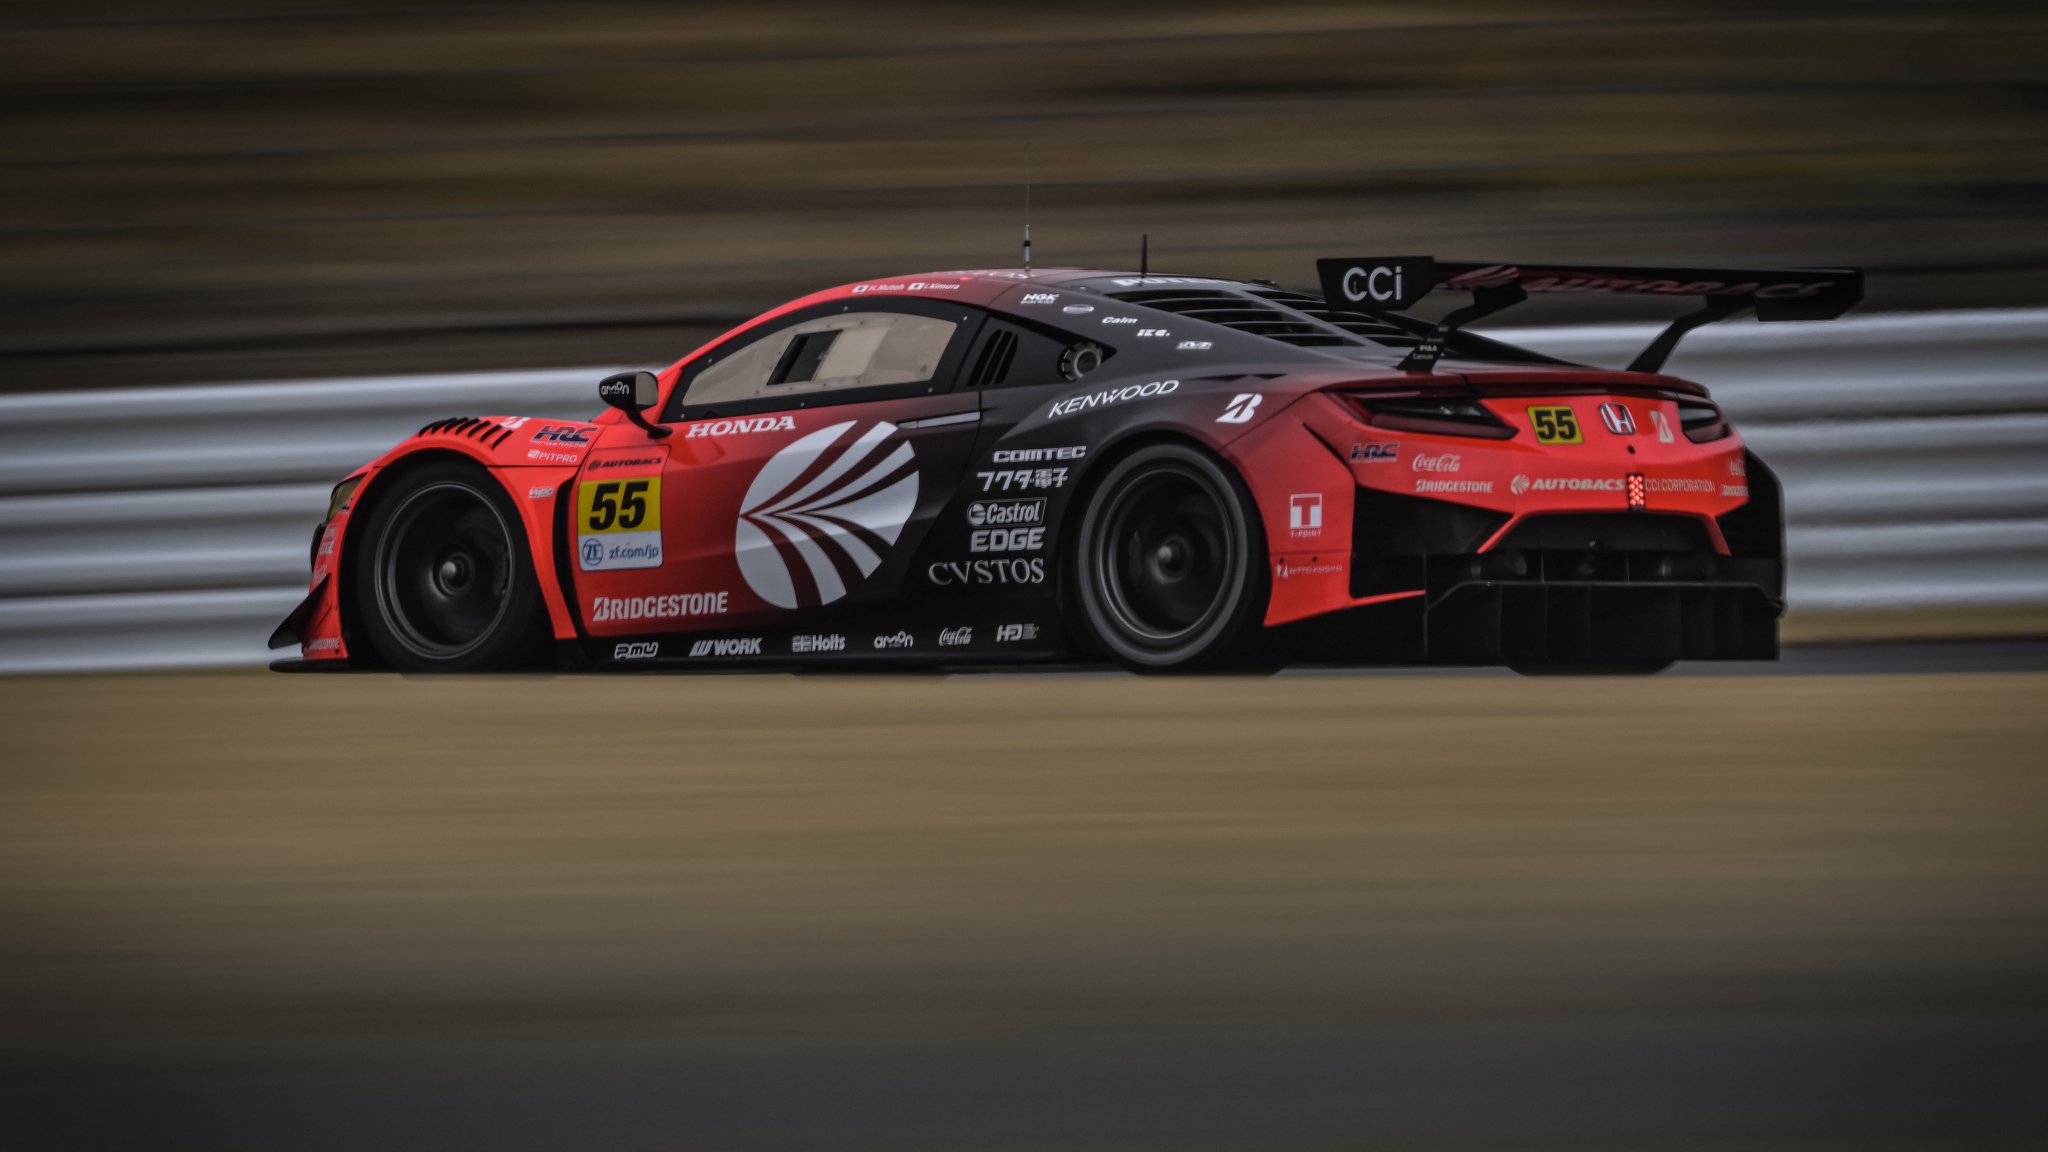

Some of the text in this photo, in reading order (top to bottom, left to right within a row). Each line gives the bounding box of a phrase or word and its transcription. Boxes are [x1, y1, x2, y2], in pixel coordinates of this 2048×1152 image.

[1048, 379, 1180, 419] KENWOOD
[533, 425, 599, 443] HRC
[685, 415, 797, 439] HONDA
[1534, 410, 1578, 440] 55
[538, 452, 578, 463] PITPRO
[600, 457, 662, 468] AUTOBACS
[993, 446, 1087, 463] COMTEC
[1416, 479, 1494, 493] BRIDGESTONE
[1532, 478, 1625, 491] AUTOBACS
[1661, 478, 1716, 493] CORPORATION
[589, 481, 650, 531] 55
[986, 501, 1041, 525] Castrol
[970, 527, 1046, 552] EDGE
[609, 544, 659, 560] zf.com/jp
[928, 557, 1045, 586] CVSTOS
[593, 591, 729, 621] BRIDGESTONE
[714, 637, 761, 656] WORK
[812, 633, 846, 652] Holts
